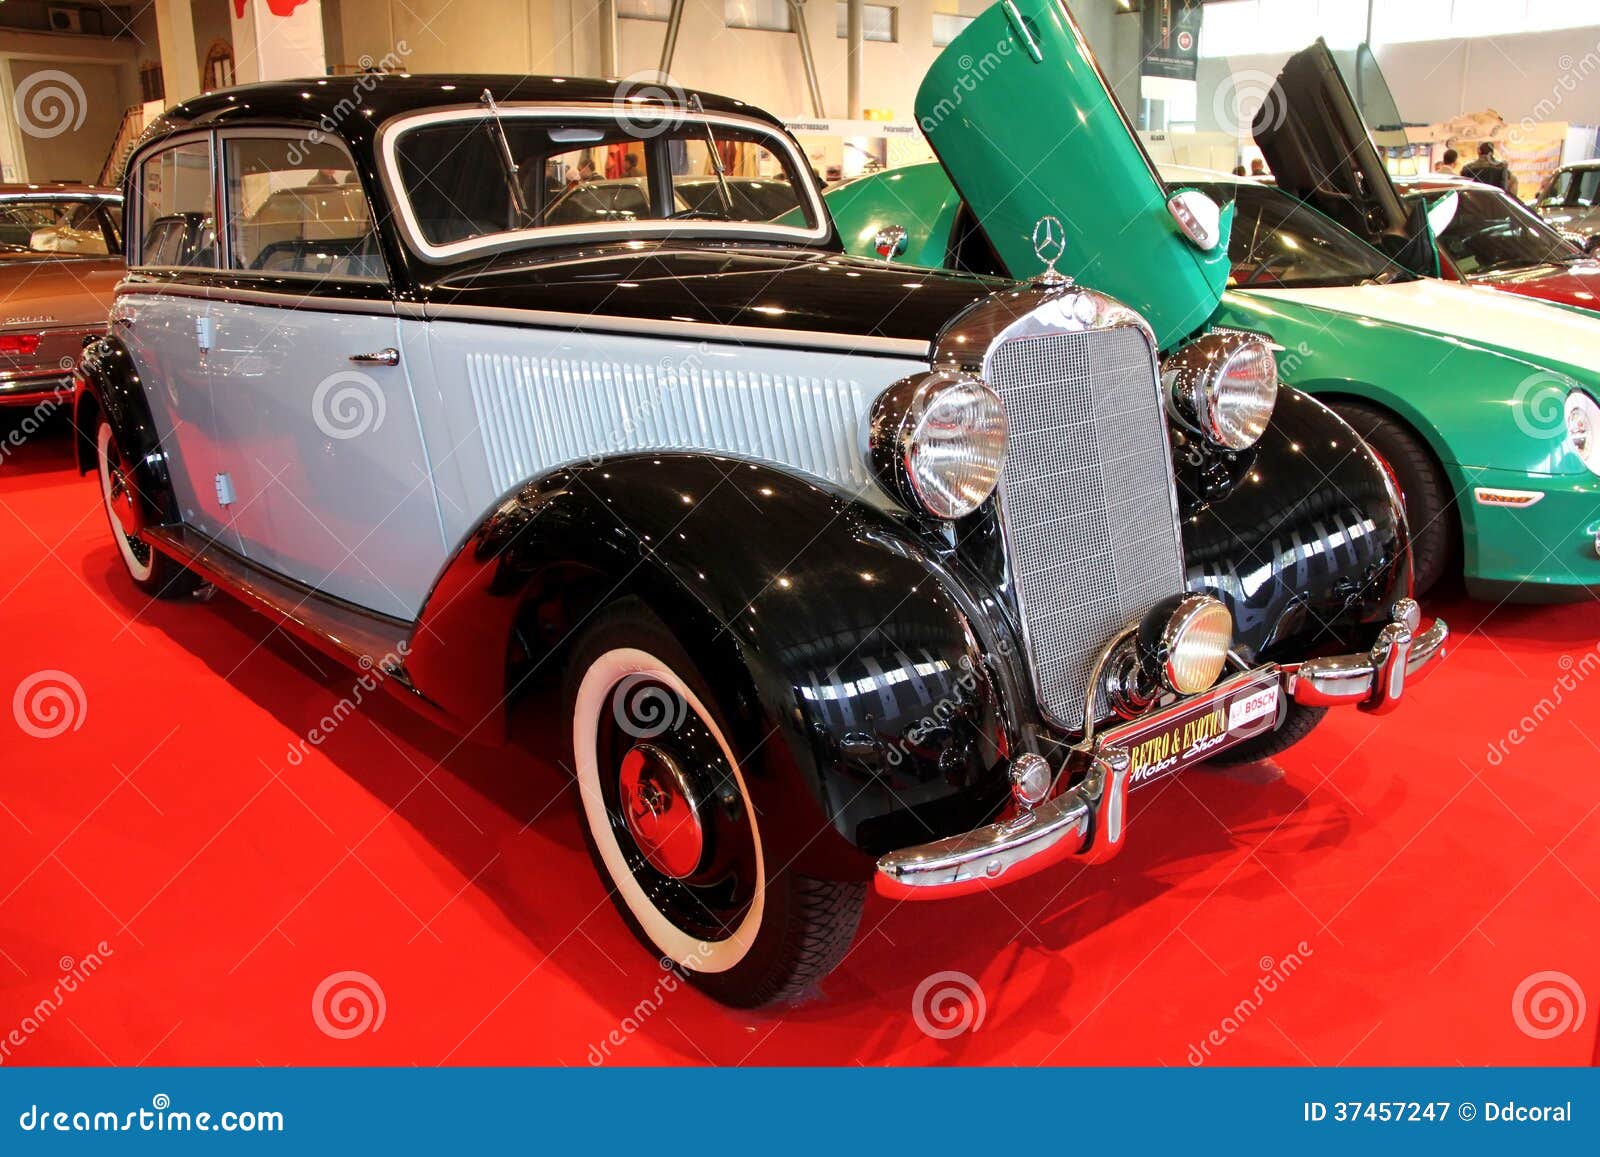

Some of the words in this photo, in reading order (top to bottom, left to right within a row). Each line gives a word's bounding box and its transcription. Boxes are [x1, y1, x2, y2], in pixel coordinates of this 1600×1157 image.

[1245, 692, 1274, 714] BOSCH
[1129, 756, 1178, 784] Motor
[1183, 732, 1228, 758] Show
[1131, 732, 1170, 773] RETRO
[1171, 727, 1181, 754] &
[1183, 707, 1227, 752] EXOTICA
